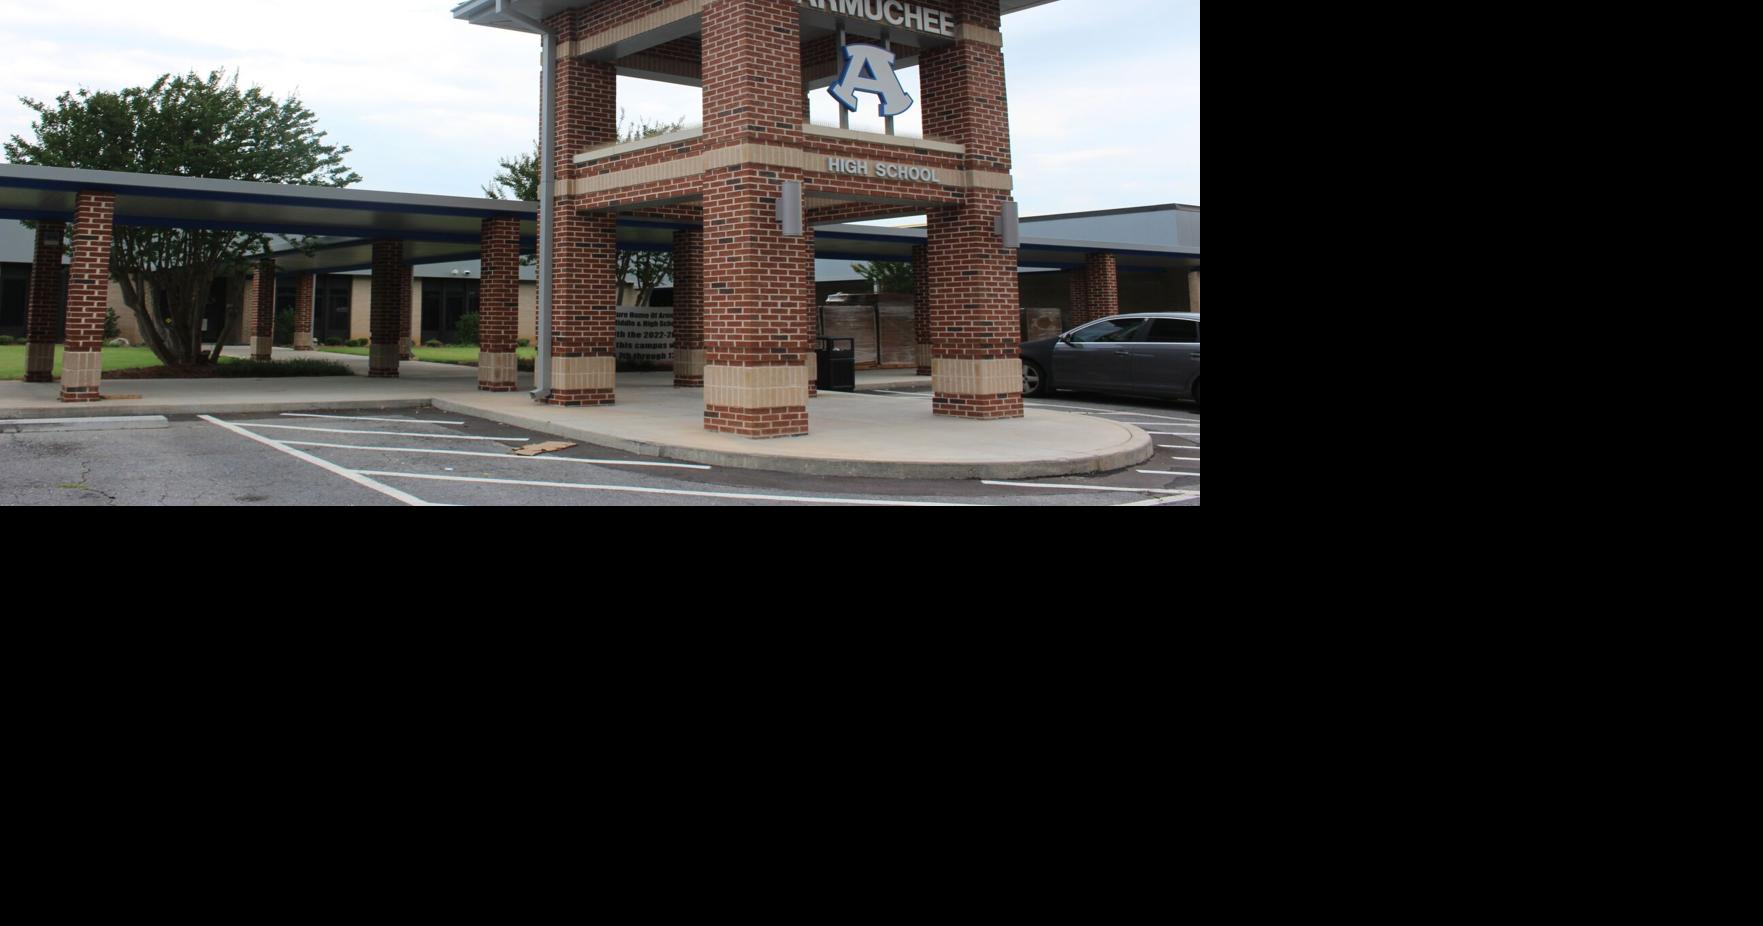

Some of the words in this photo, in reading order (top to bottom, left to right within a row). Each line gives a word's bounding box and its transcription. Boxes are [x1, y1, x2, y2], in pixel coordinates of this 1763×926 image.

[797, 0, 955, 37] MUCHEE
[827, 43, 914, 117] A
[828, 157, 868, 175] HIGH
[875, 162, 940, 183] SCHOOL
[633, 352, 666, 361] through
[634, 342, 667, 350] campus
